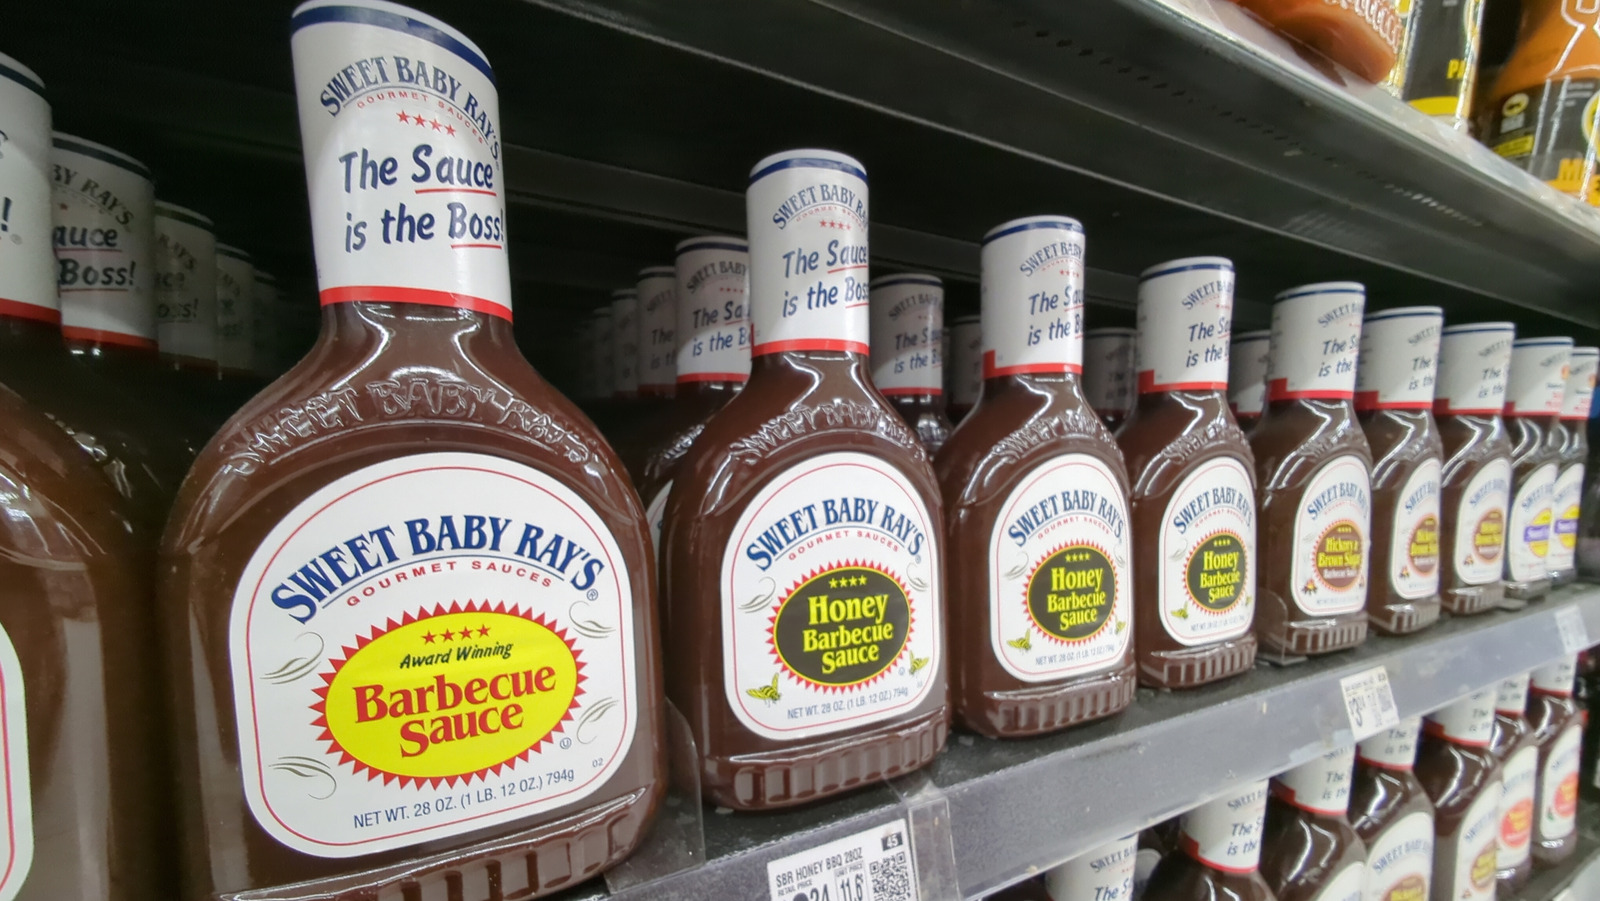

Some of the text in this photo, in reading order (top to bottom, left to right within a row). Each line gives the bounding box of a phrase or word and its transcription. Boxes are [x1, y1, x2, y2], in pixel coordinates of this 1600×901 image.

[320, 56, 500, 159] SWEET BABY RAY'S
[357, 90, 483, 144] GOURMET SAUCES
[339, 144, 494, 193] The Sauce
[772, 184, 856, 230] SWEET BABY
[345, 202, 504, 253] is the Boss!
[59, 258, 136, 287] Boss!
[782, 247, 819, 278] The
[1020, 243, 1057, 277] SWEET
[782, 290, 799, 318] is
[807, 281, 839, 310] the
[1028, 291, 1059, 315] The
[1182, 281, 1214, 310] SWEET
[693, 307, 718, 328] The
[1028, 317, 1071, 346] is the
[1188, 322, 1214, 342] The
[693, 331, 733, 357] is the
[895, 331, 918, 350] The
[1323, 338, 1347, 355] The
[894, 353, 928, 374] is the
[1186, 349, 1199, 368] is
[1205, 344, 1222, 363] the
[1318, 362, 1331, 377] is
[1412, 357, 1431, 371] The
[1173, 491, 1210, 534] SWEET
[1213, 486, 1236, 505] BABY
[1307, 483, 1340, 520] SWEET
[1008, 489, 1123, 547] SWEET BABY RAY'S
[746, 497, 925, 572] SWEET BABY RAY'S
[788, 530, 899, 561] GOURMET SAUCES
[271, 515, 605, 625] SWEET BABY RAY'S
[1203, 550, 1239, 571] Honey
[347, 560, 552, 606] GOURMET SAUCES
[1051, 566, 1103, 592] Honey
[1200, 568, 1240, 589] Barbecue
[1047, 591, 1106, 613] Barbecue
[1208, 584, 1235, 604] Sauce
[808, 593, 889, 626] Honey
[1060, 608, 1097, 631] Sauce
[803, 622, 893, 652] Barbecue
[399, 641, 514, 670] Award Winning
[821, 644, 880, 675] Sauce
[353, 664, 556, 724] Barbecue
[787, 708, 803, 719] NET
[804, 705, 819, 717] WT.
[821, 703, 831, 714] 28
[833, 700, 845, 711] OZ.
[856, 696, 867, 707] LB.
[869, 693, 878, 704] 12
[399, 703, 524, 759] Sauce
[592, 758, 604, 768] 02
[353, 769, 575, 829] NET WT. 28 OZ. (1 LB. 12 OZ.) 794g
[886, 834, 898, 848] 45
[1231, 823, 1253, 837] The
[1227, 841, 1237, 856] is
[776, 848, 863, 888] SBR HONEY BBQ 28OZ
[1094, 883, 1118, 901] The
